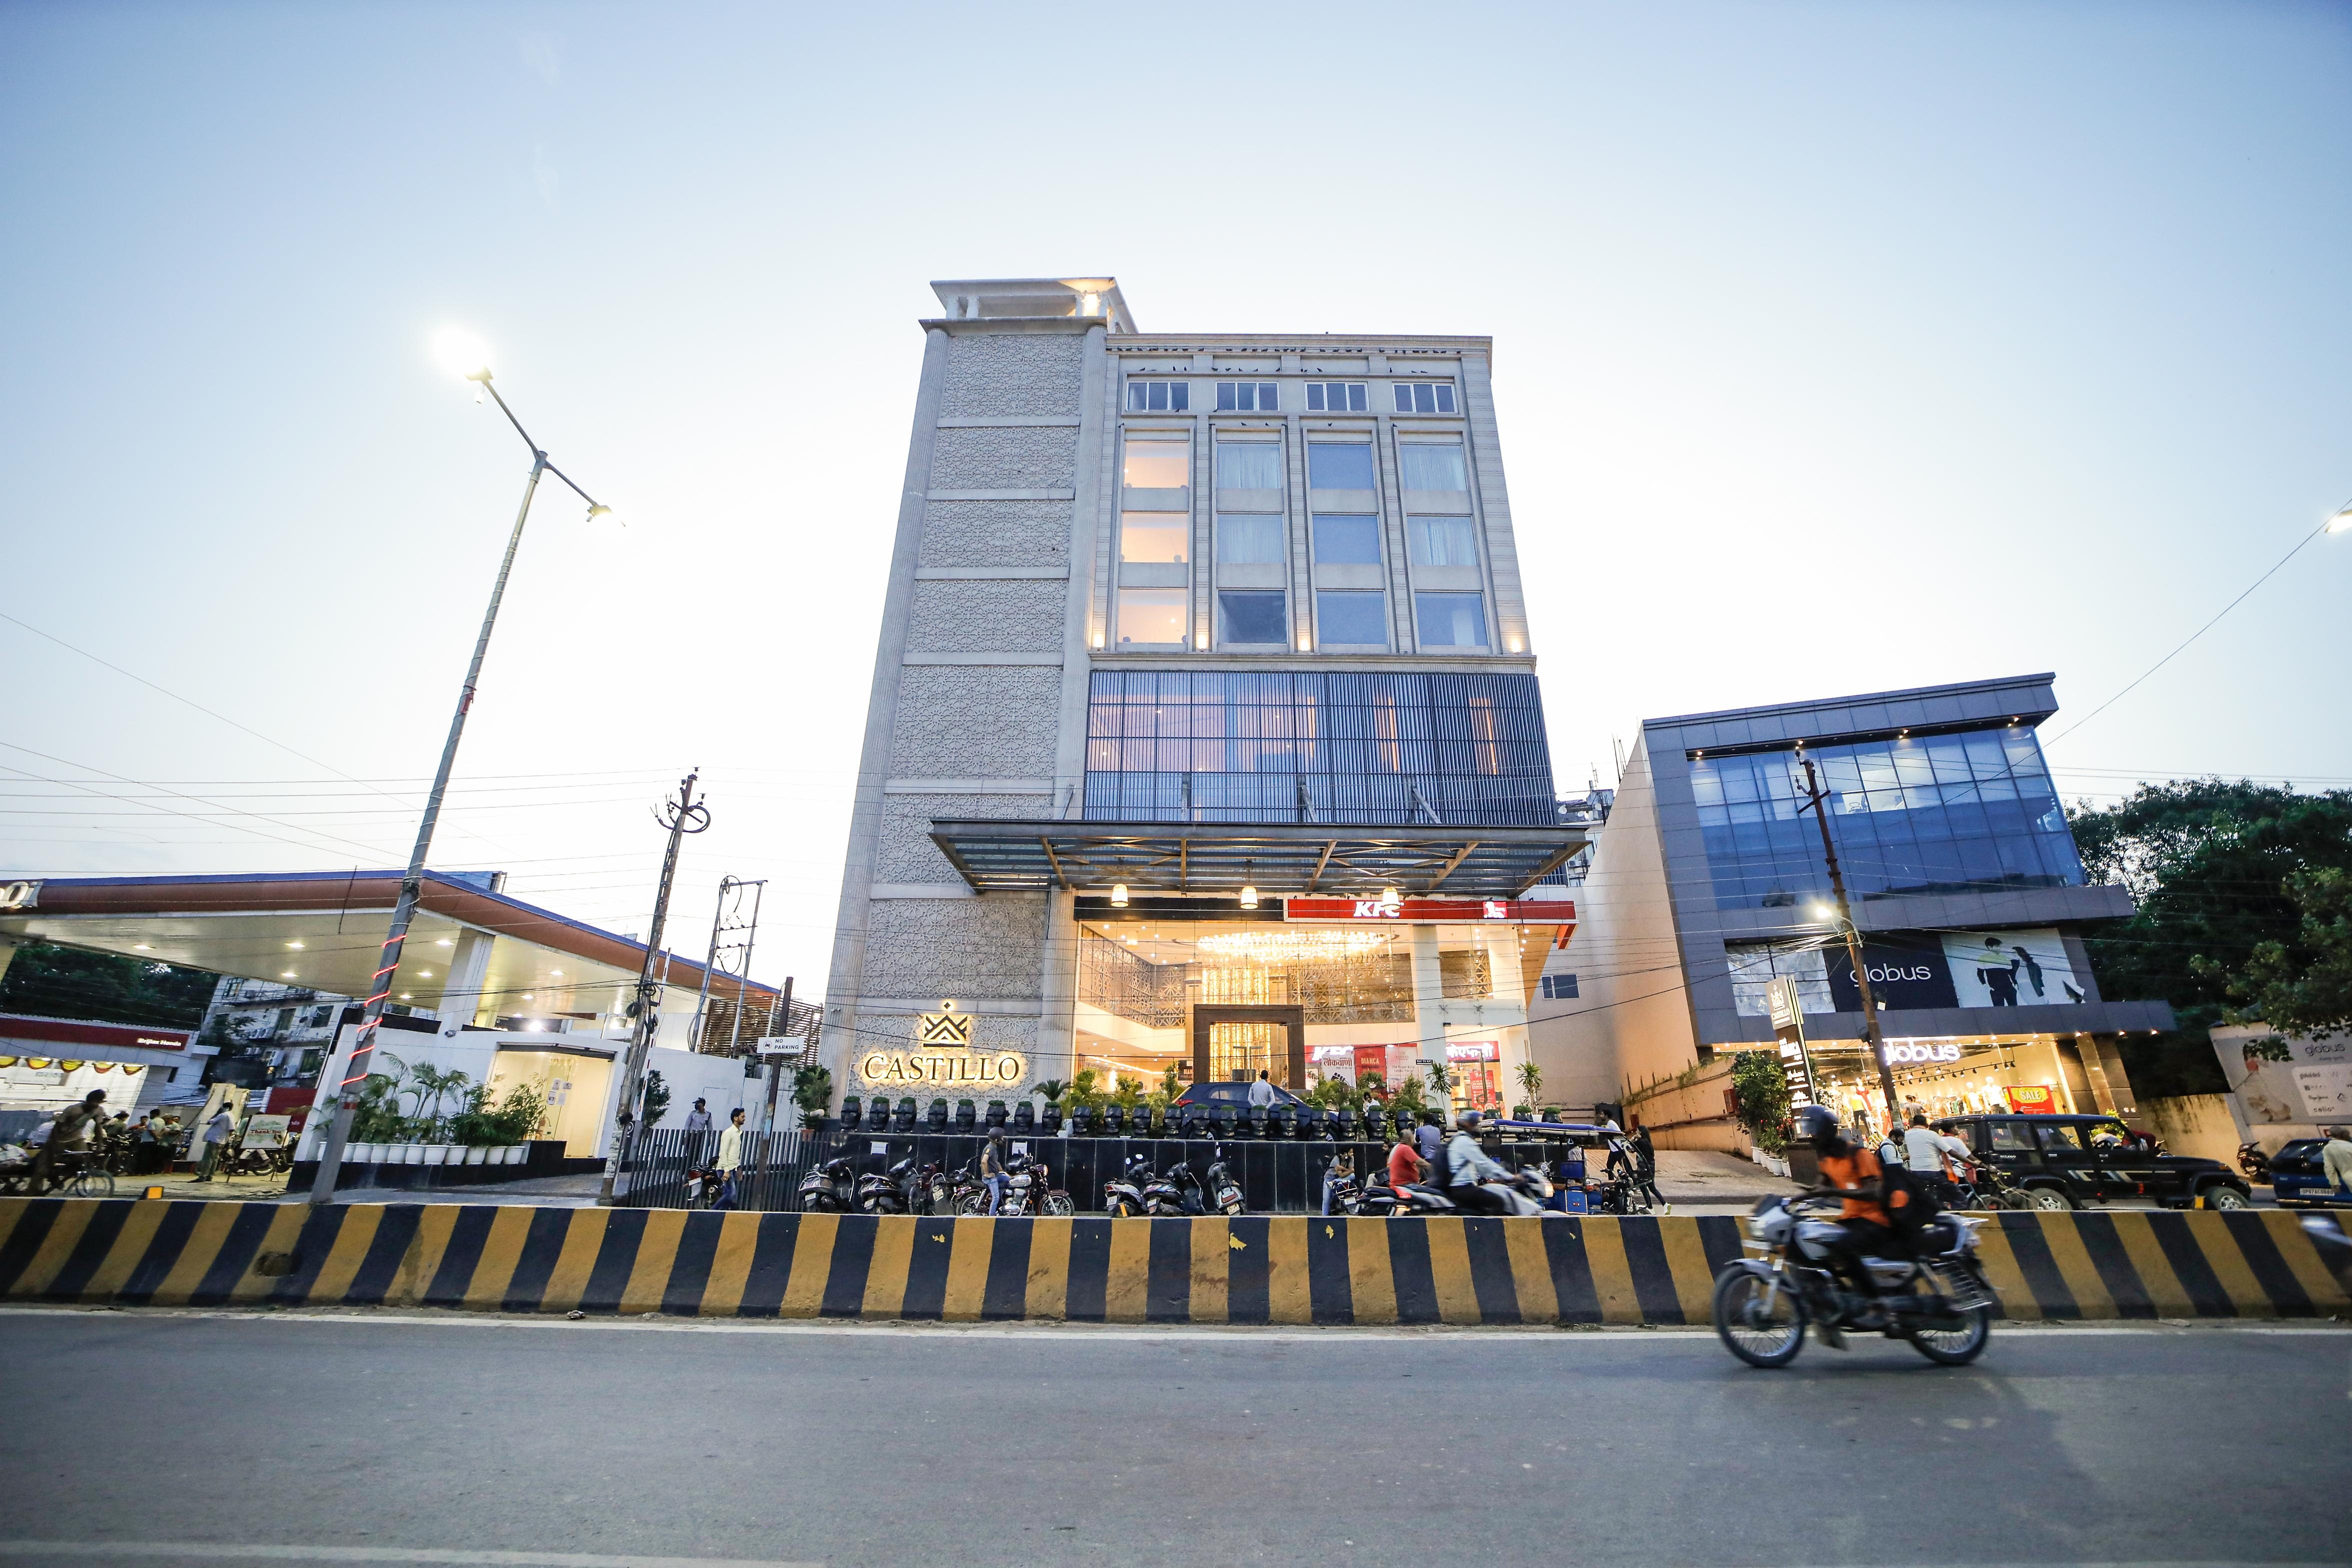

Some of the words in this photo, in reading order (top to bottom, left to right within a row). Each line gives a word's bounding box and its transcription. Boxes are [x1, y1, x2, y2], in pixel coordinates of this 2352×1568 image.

[1354, 901, 1404, 917] KFC
[2304, 1044, 2345, 1056] globus
[864, 1056, 1020, 1080] CASTILLO
[2020, 1090, 2041, 1100] SALE
